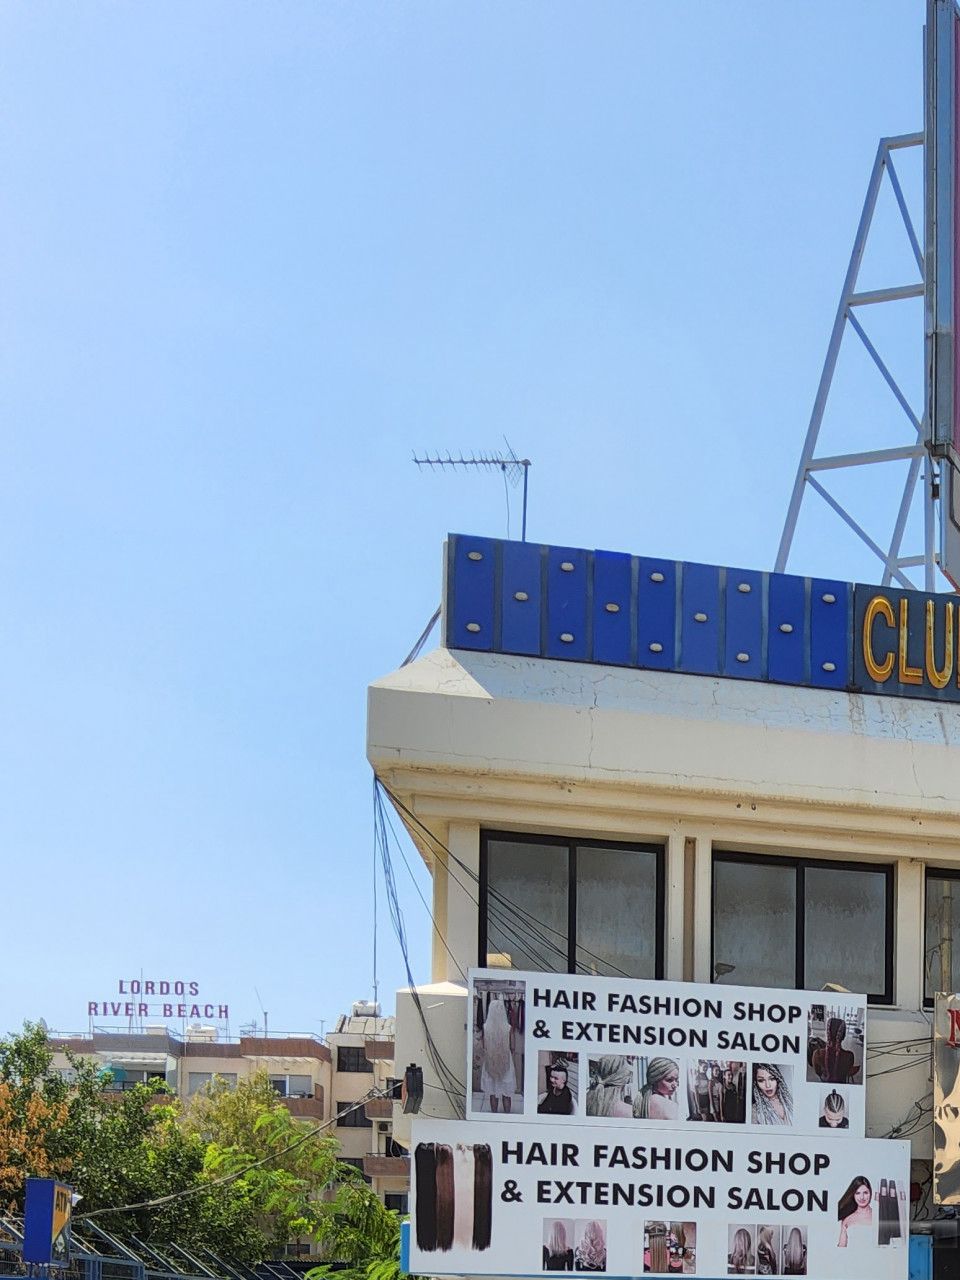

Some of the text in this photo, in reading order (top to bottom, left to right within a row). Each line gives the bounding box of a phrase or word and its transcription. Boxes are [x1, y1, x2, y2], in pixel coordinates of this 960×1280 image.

[118, 979, 199, 996] LORDOS
[88, 1001, 229, 1019] RIVER BEACH
[532, 988, 802, 1024] HAIR FASHION SHOP
[532, 1019, 800, 1054] & EXTENSION SALON
[501, 1141, 831, 1176] HAIR FASHION SHOP
[500, 1179, 828, 1213] & EXTENSION SALON
